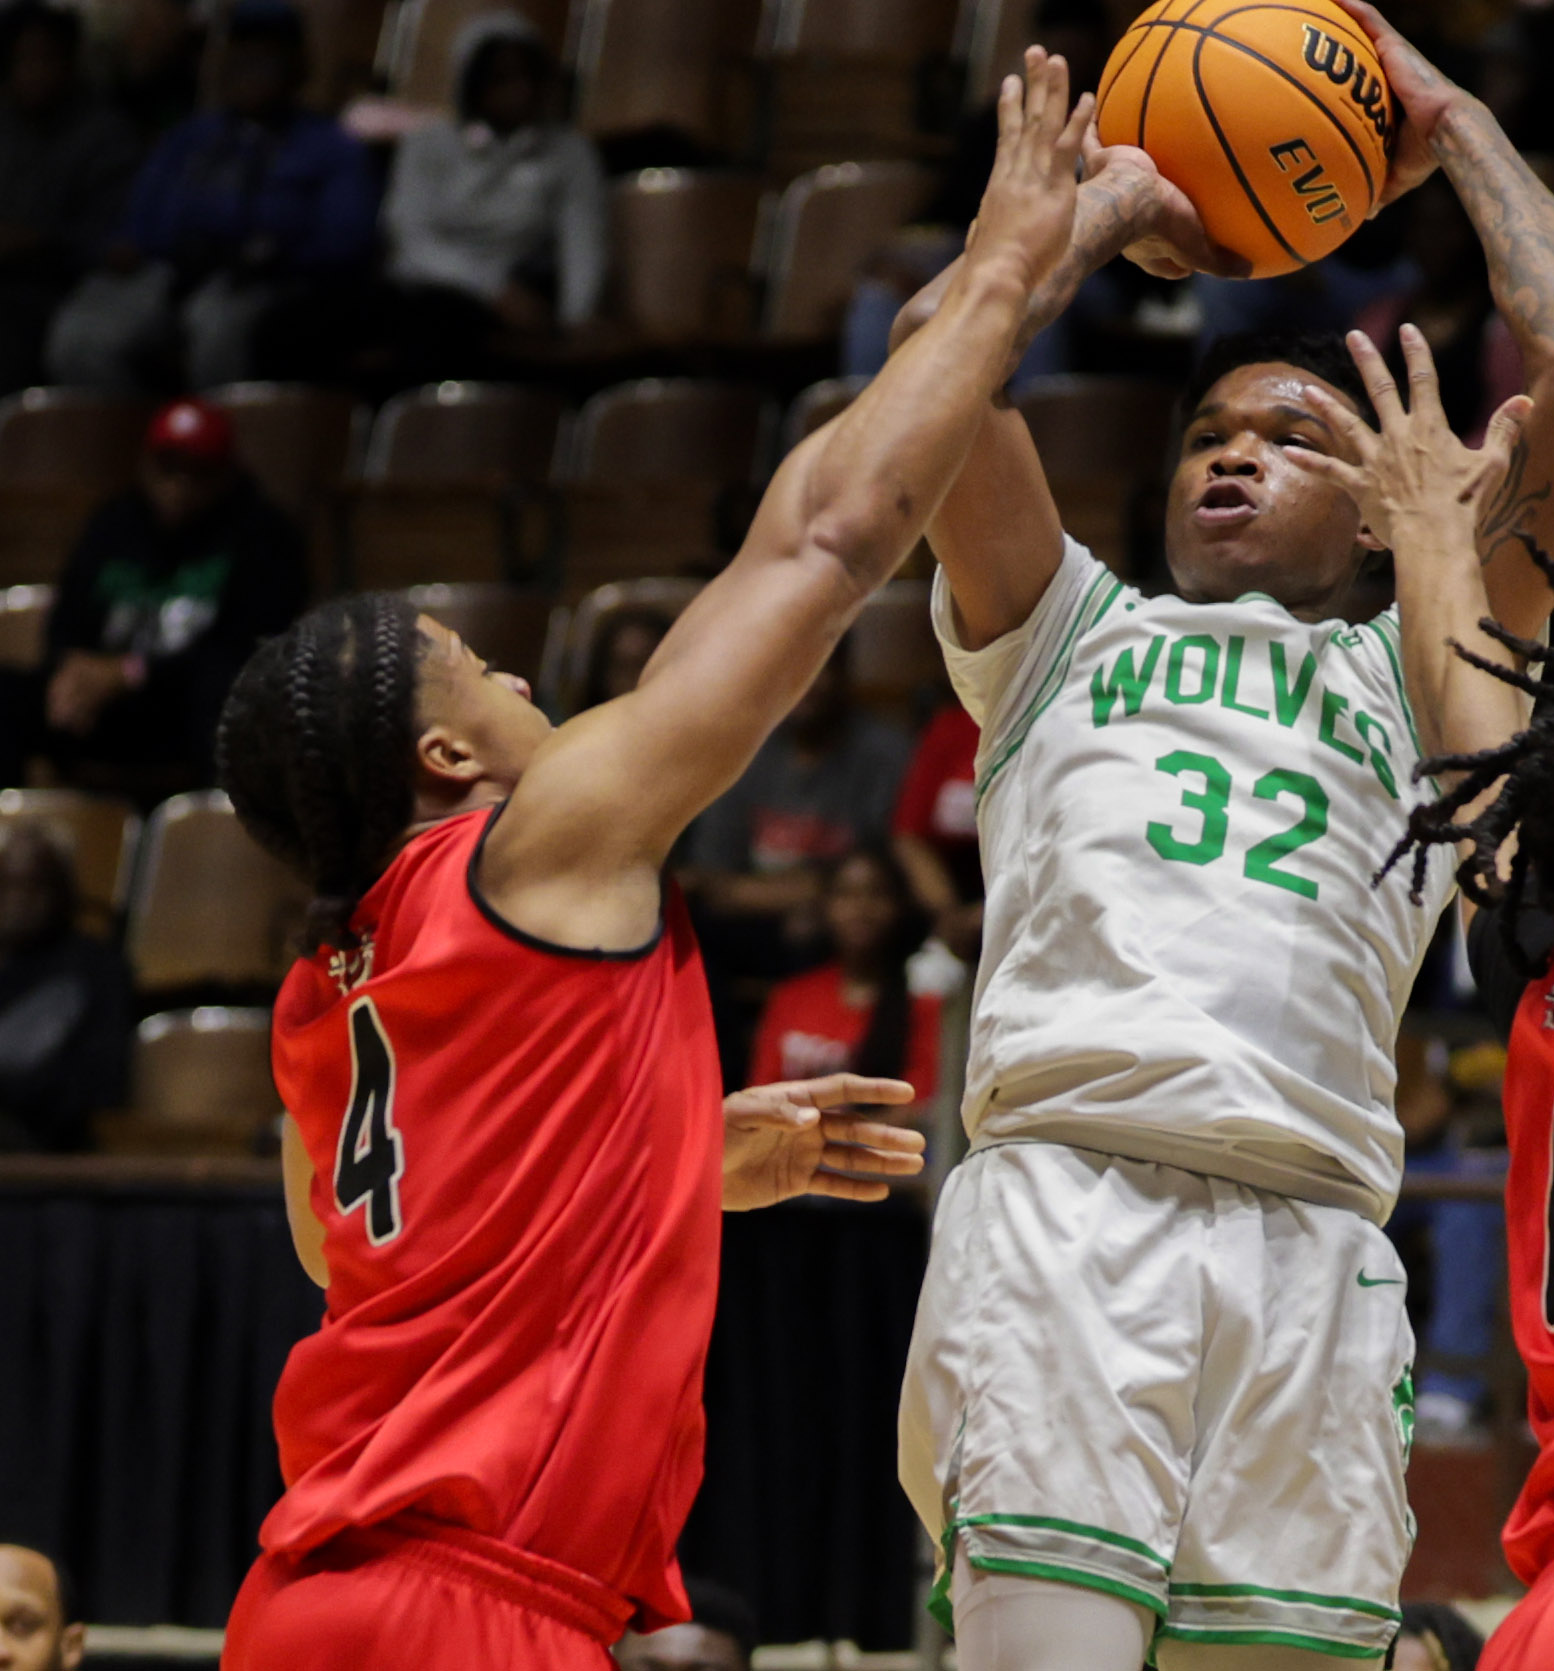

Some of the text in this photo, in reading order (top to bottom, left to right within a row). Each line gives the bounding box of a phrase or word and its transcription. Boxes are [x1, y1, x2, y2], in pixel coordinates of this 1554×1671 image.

[1269, 137, 1347, 224] EVO
[1089, 634, 1400, 799] WOLVES
[1146, 749, 1330, 901] 32
[333, 994, 405, 1248] 4
